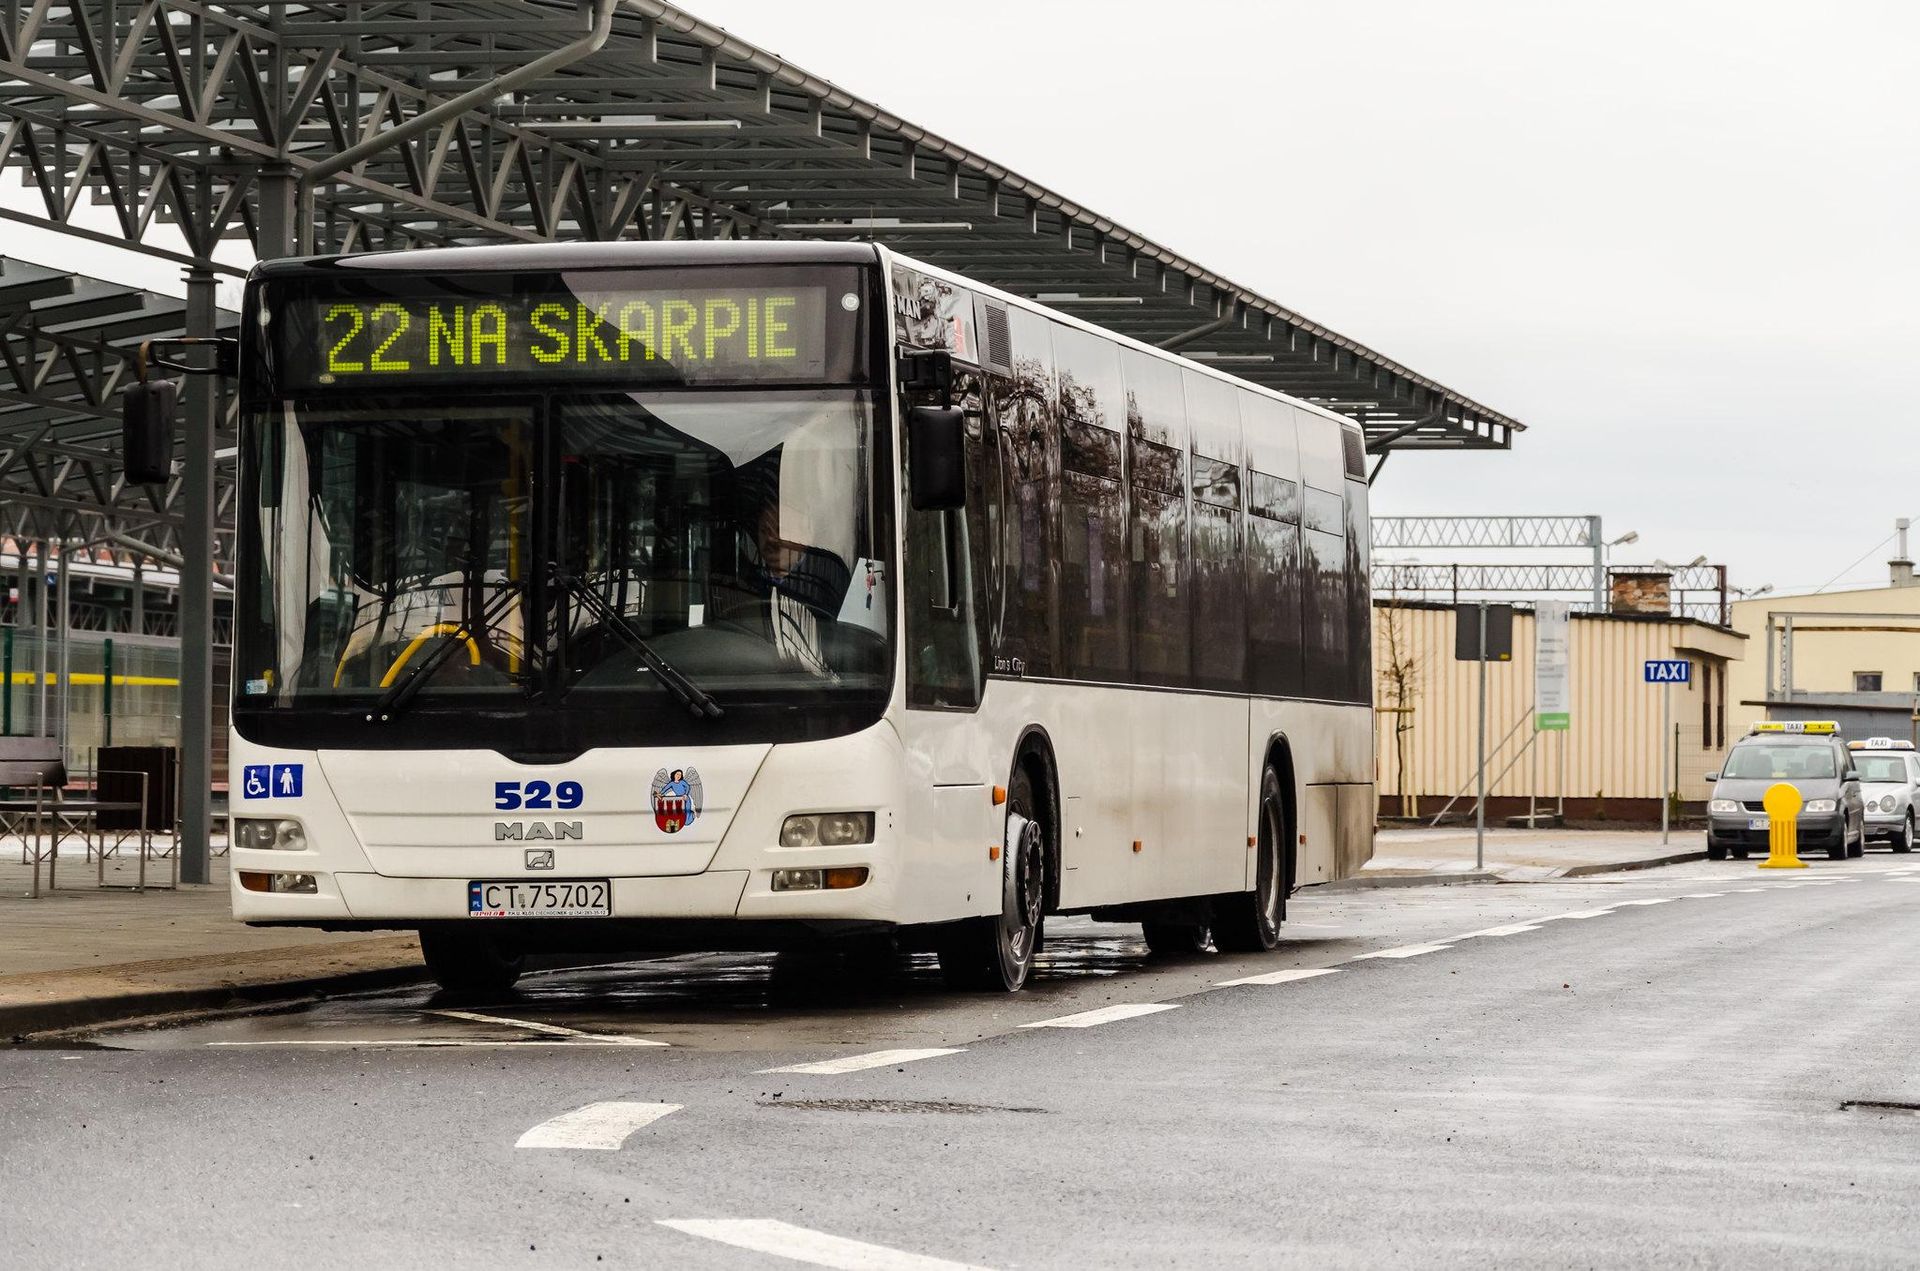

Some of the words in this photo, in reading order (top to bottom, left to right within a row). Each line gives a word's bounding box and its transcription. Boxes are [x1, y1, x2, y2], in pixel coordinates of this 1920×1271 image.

[326, 302, 410, 372] 22
[429, 302, 507, 366] NA
[530, 296, 796, 364] SKARPIE
[1646, 663, 1686, 680] TAXI
[1786, 723, 1801, 731] TAXI
[1870, 738, 1888, 747] TAXI
[495, 780, 584, 811] 529
[495, 821, 583, 840] MAN
[486, 885, 519, 909] CT
[529, 884, 604, 909] 75702
